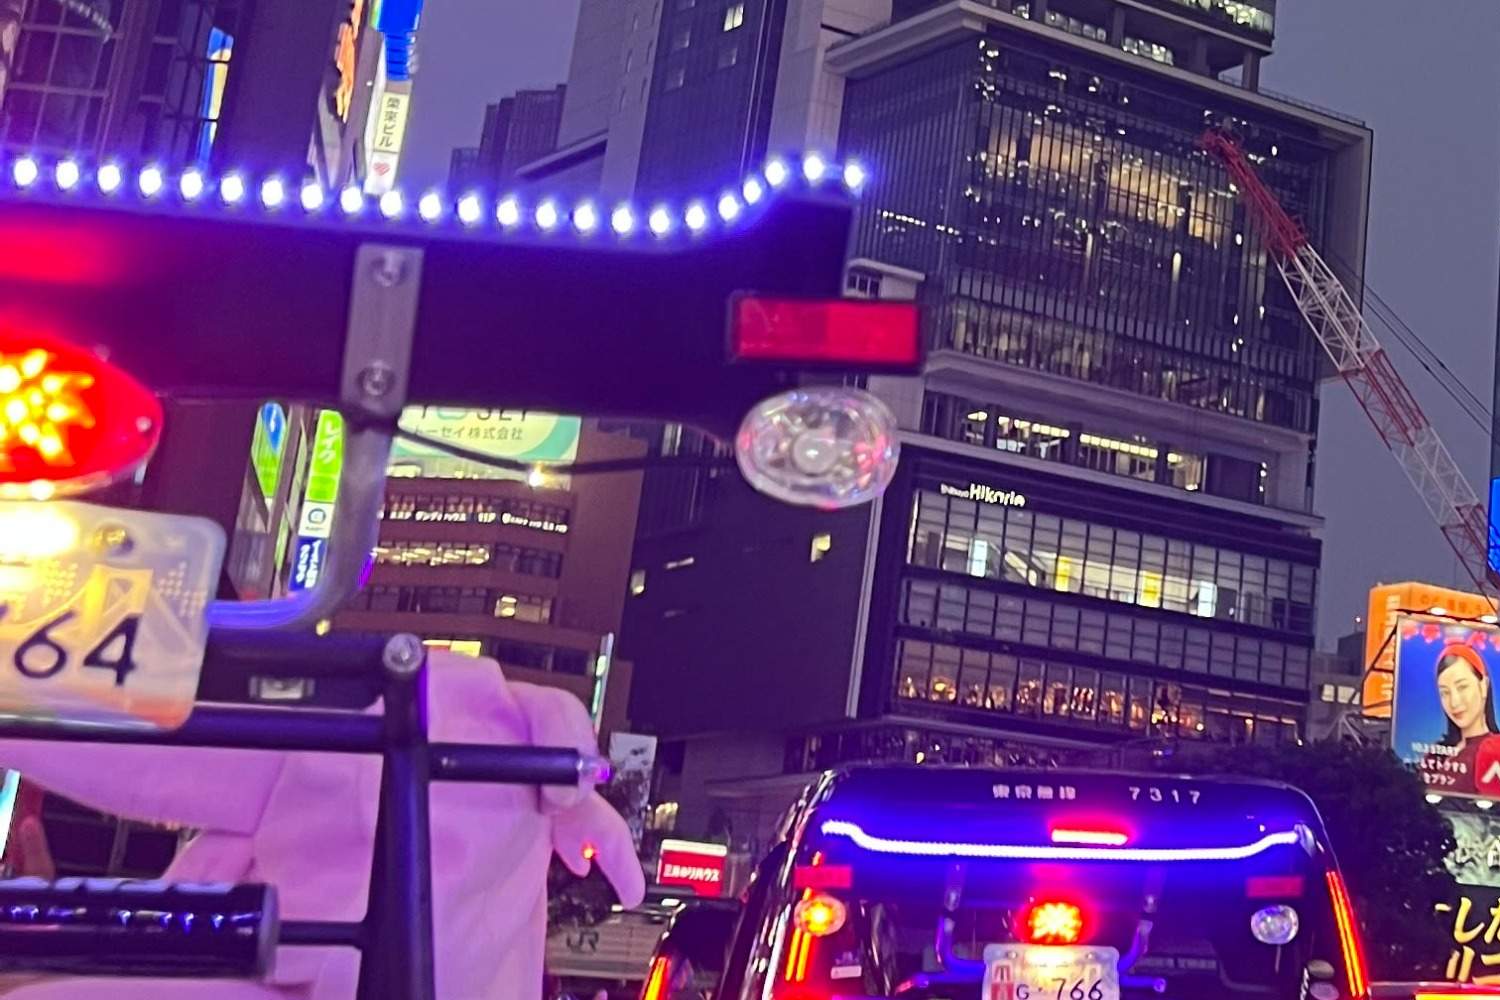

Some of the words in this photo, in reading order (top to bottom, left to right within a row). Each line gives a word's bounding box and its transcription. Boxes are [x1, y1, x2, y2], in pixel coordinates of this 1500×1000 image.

[413, 424, 524, 440] トーセイ株式会社
[969, 483, 1026, 507] Hikarie
[566, 930, 600, 952] JR
